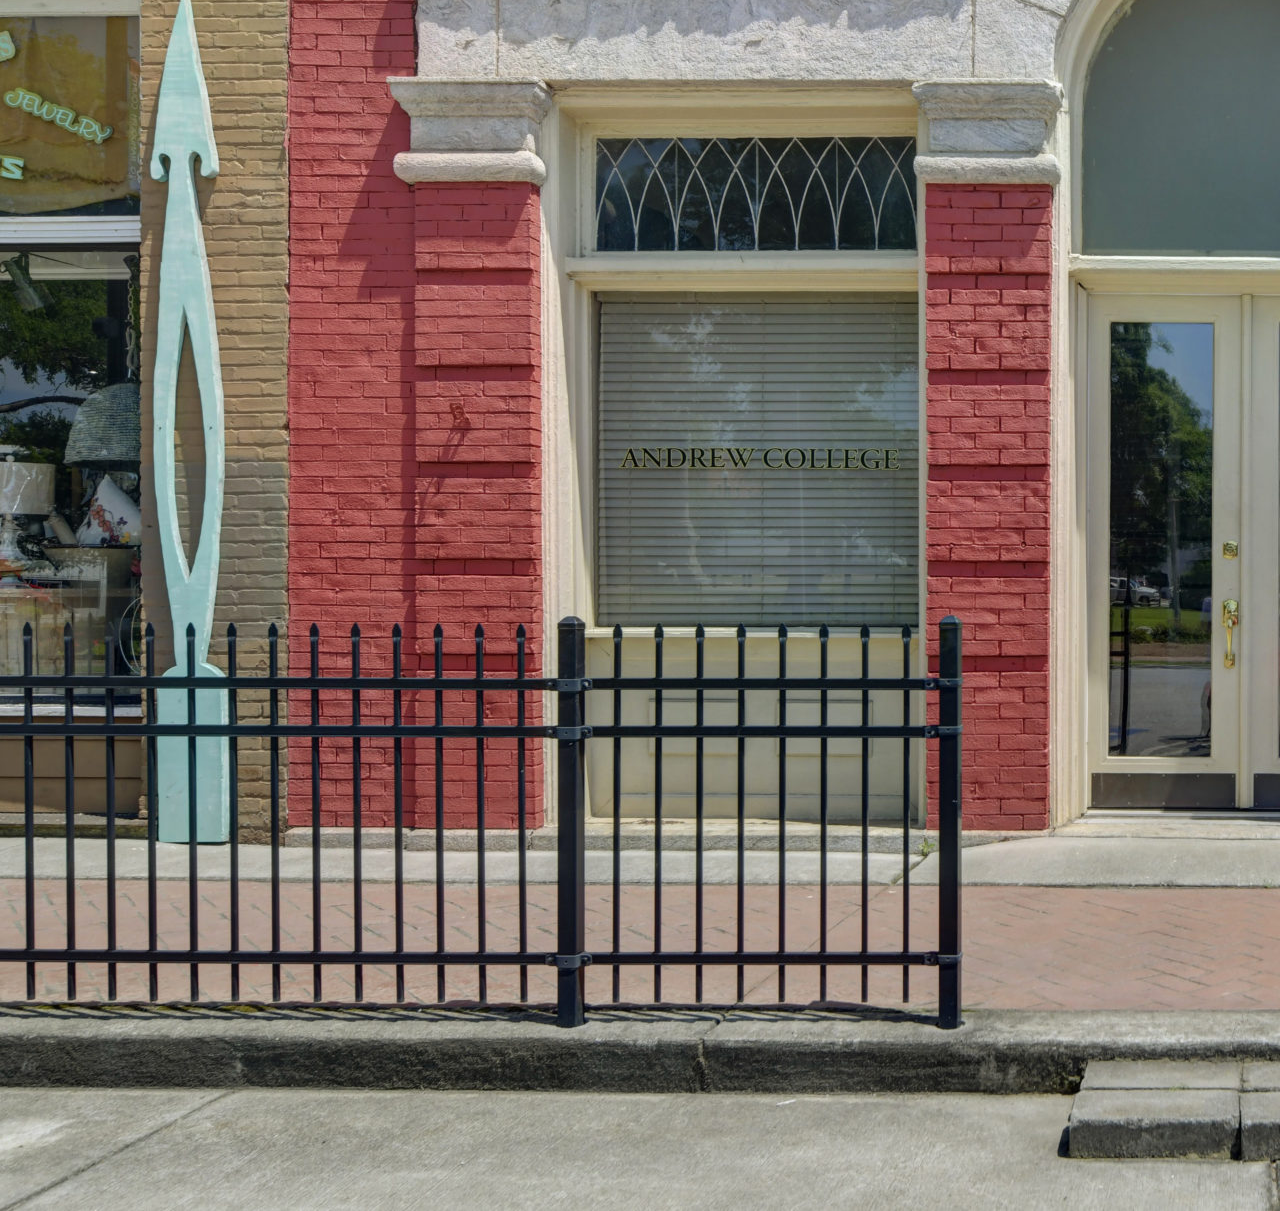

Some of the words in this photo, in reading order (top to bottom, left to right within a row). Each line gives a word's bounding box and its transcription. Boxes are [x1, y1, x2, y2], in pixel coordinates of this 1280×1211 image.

[5, 89, 113, 144] JEWELRY
[619, 447, 756, 469] ANDREW
[762, 447, 900, 470] COLLEGE
